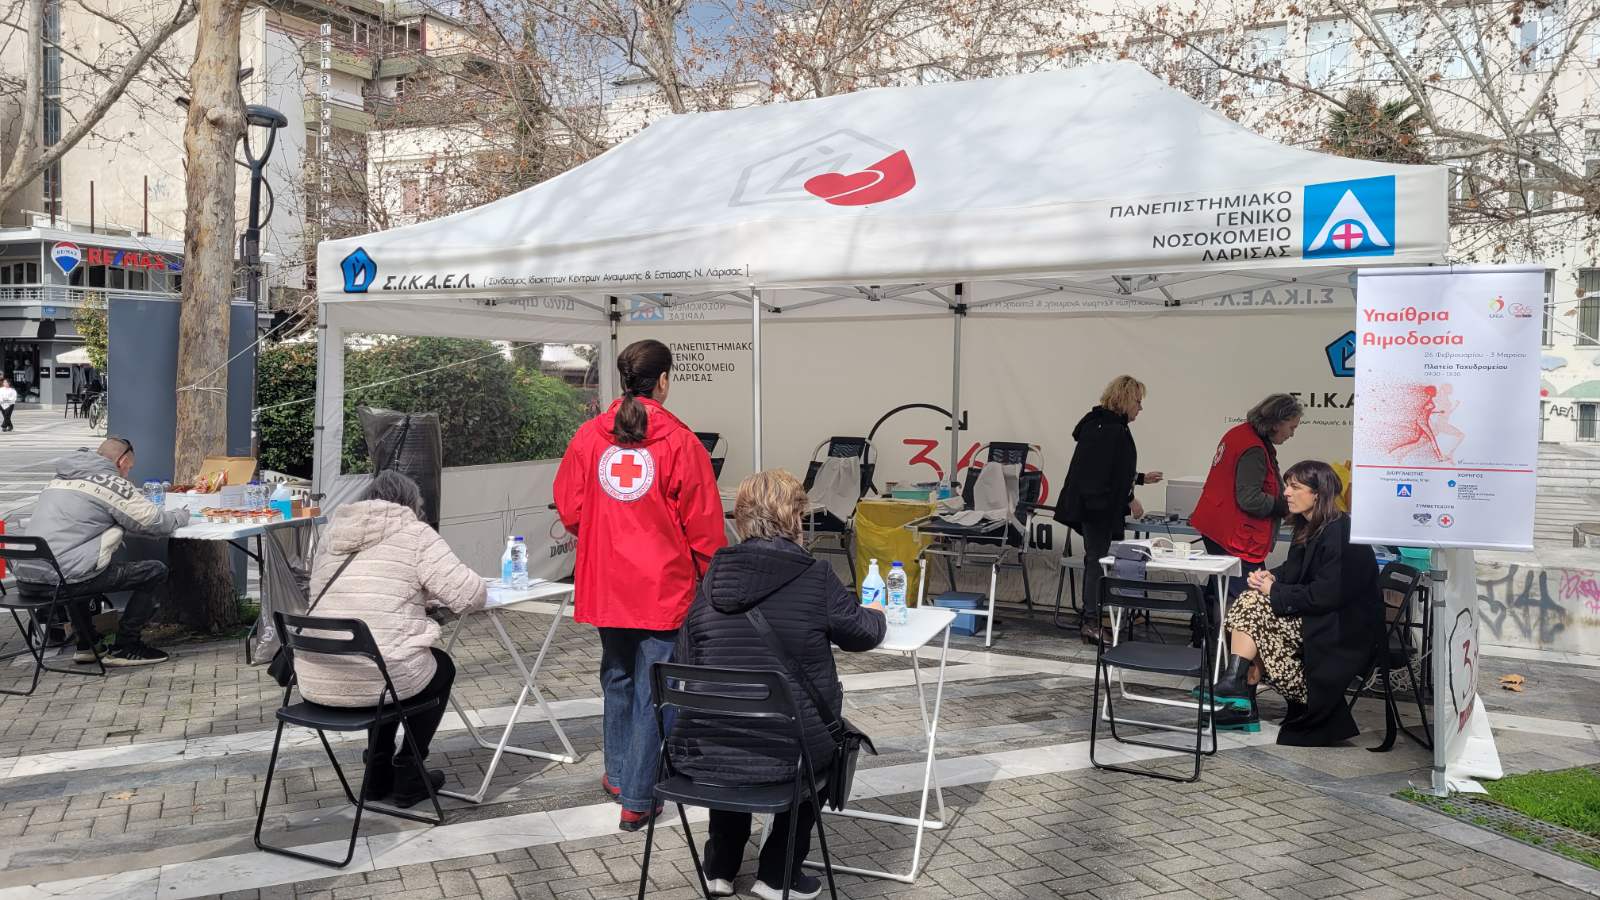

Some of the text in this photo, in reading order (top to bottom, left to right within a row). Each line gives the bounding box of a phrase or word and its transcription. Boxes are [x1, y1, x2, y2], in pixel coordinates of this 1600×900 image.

[1110, 190, 1292, 219] ΠΑΝΕΠΙΣΤΗΜΙΑΚΟ
[1216, 207, 1292, 227] ΓΕΝΙΚΟ
[1152, 226, 1292, 249] ΝΟΣΟΚΟΜΕΙΟ
[87, 247, 165, 272] RE/MAX
[1202, 245, 1291, 262] ΛΑΡΙΣΑΣ
[645, 270, 652, 280] &
[1363, 306, 1449, 325] Υπαίθρια
[1363, 330, 1464, 349] Αιμοδοσία
[671, 362, 735, 372] ΝΟΣΟΚΟΜΕΙΟ
[673, 373, 713, 382] ΛΑΡΙΣΑΣ
